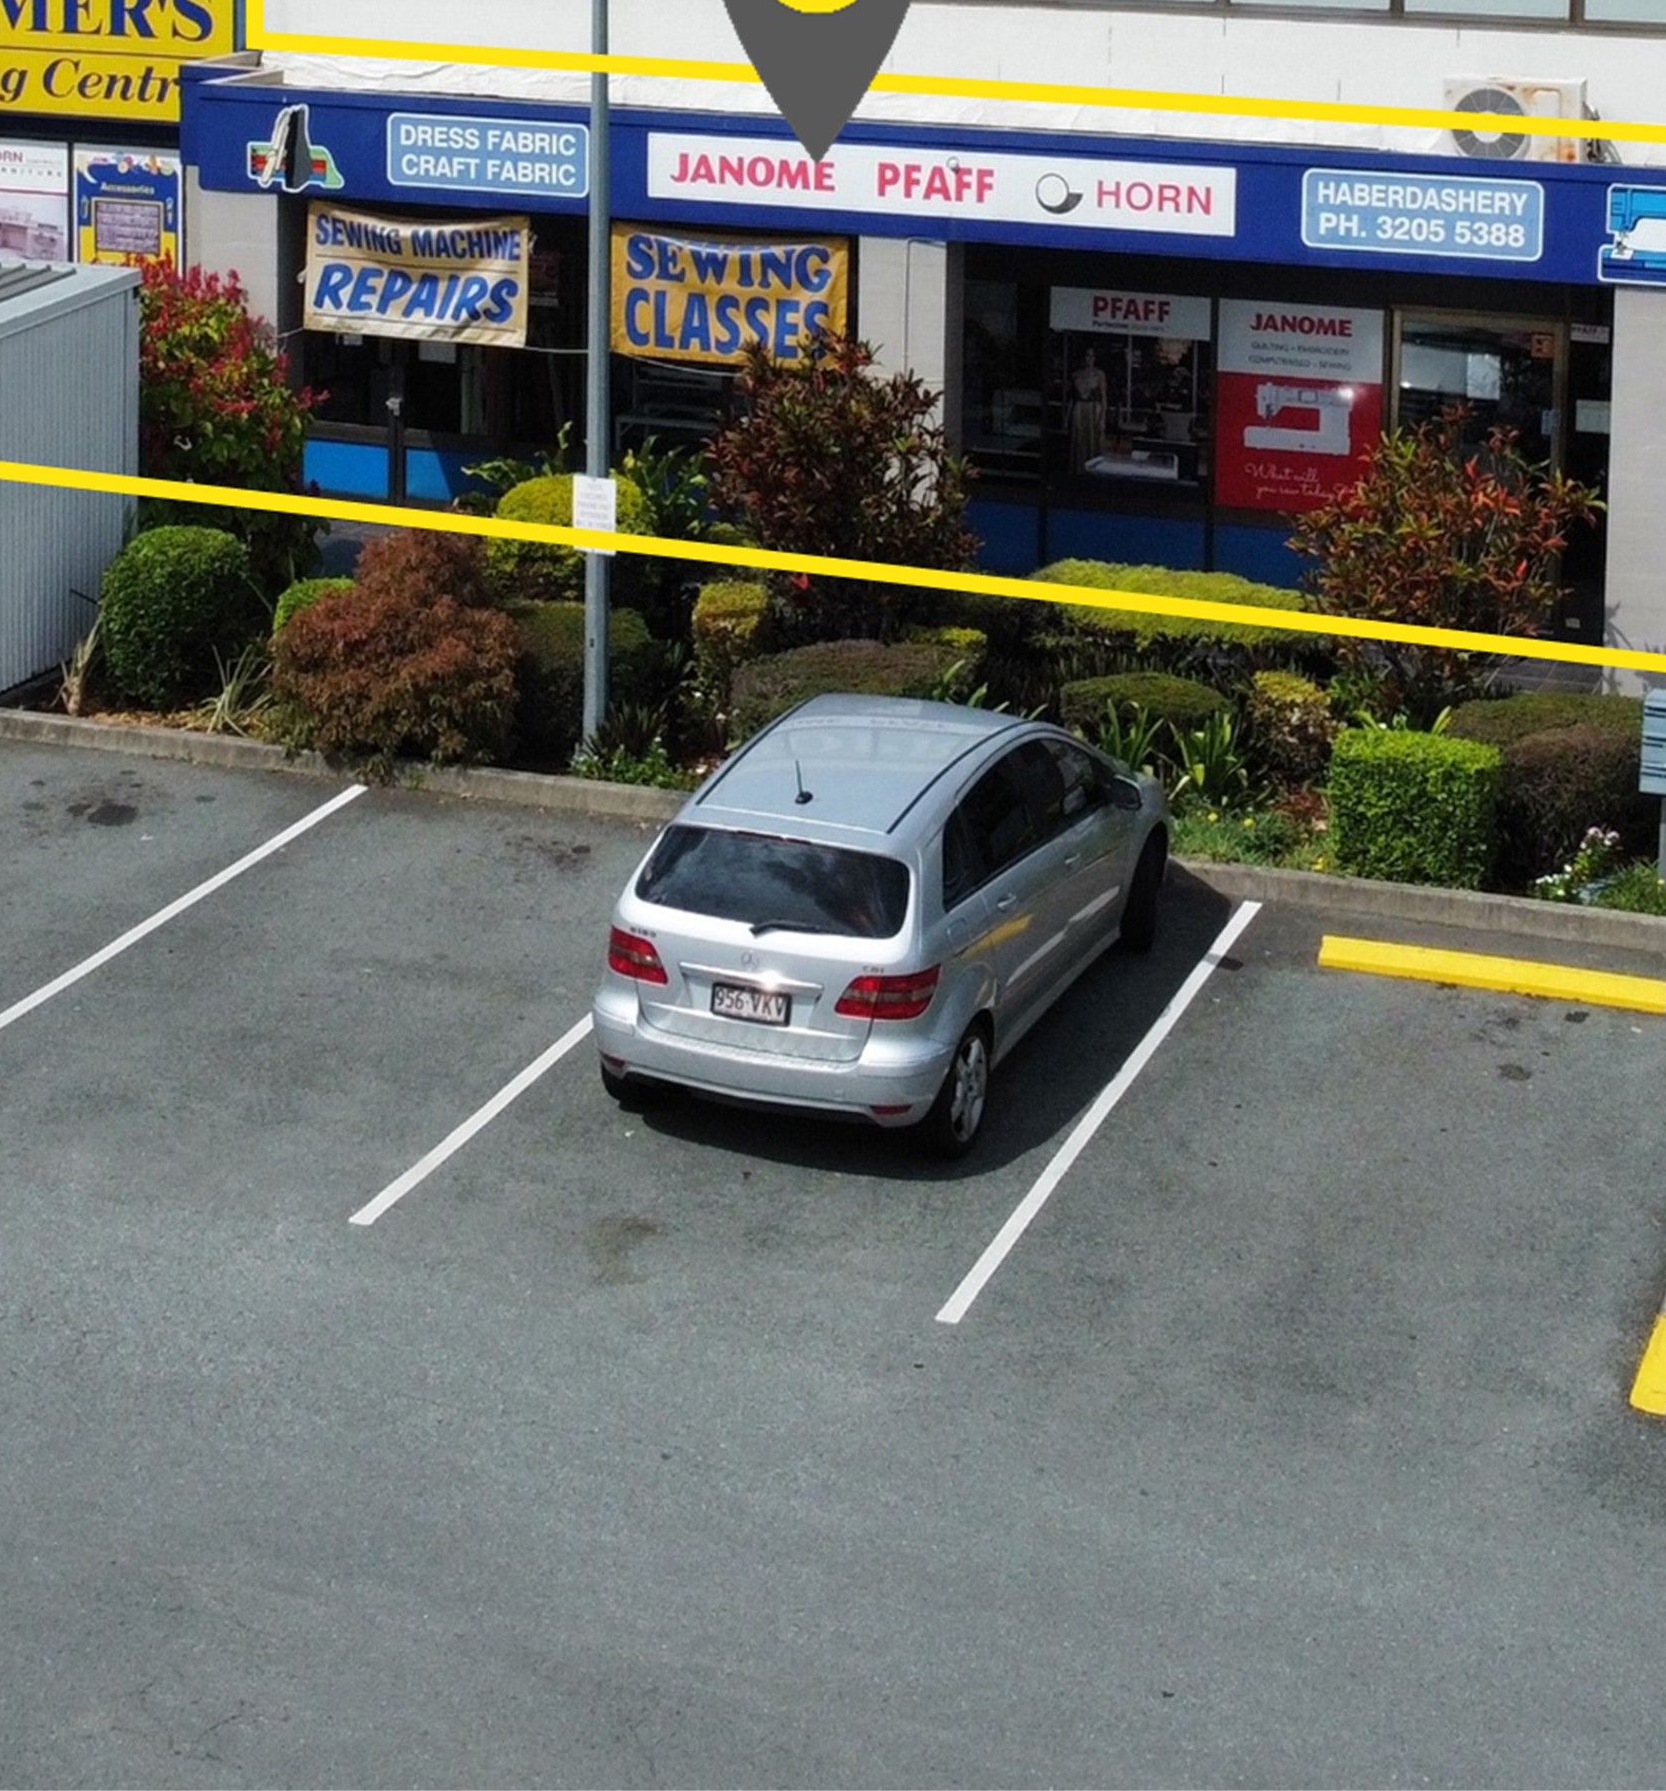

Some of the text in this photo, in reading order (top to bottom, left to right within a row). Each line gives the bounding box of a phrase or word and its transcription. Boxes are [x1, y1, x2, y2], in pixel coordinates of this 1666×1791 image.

[42, 58, 180, 104] Centr
[399, 124, 576, 157] DRESS FABRIC
[401, 153, 576, 186] CRAFT FABRIC
[670, 152, 1212, 215] JANOME PFAFF HORN
[1317, 180, 1528, 217] HABERDASHERY
[315, 213, 521, 262] SEWING MACHINE
[1319, 214, 1525, 249] PH. 3205 5388
[626, 234, 831, 292] SEWING
[313, 263, 519, 324] REPAIRS
[1093, 296, 1170, 323] PFAFF
[625, 287, 829, 359] CLASSES
[1250, 312, 1353, 337] JANOME
